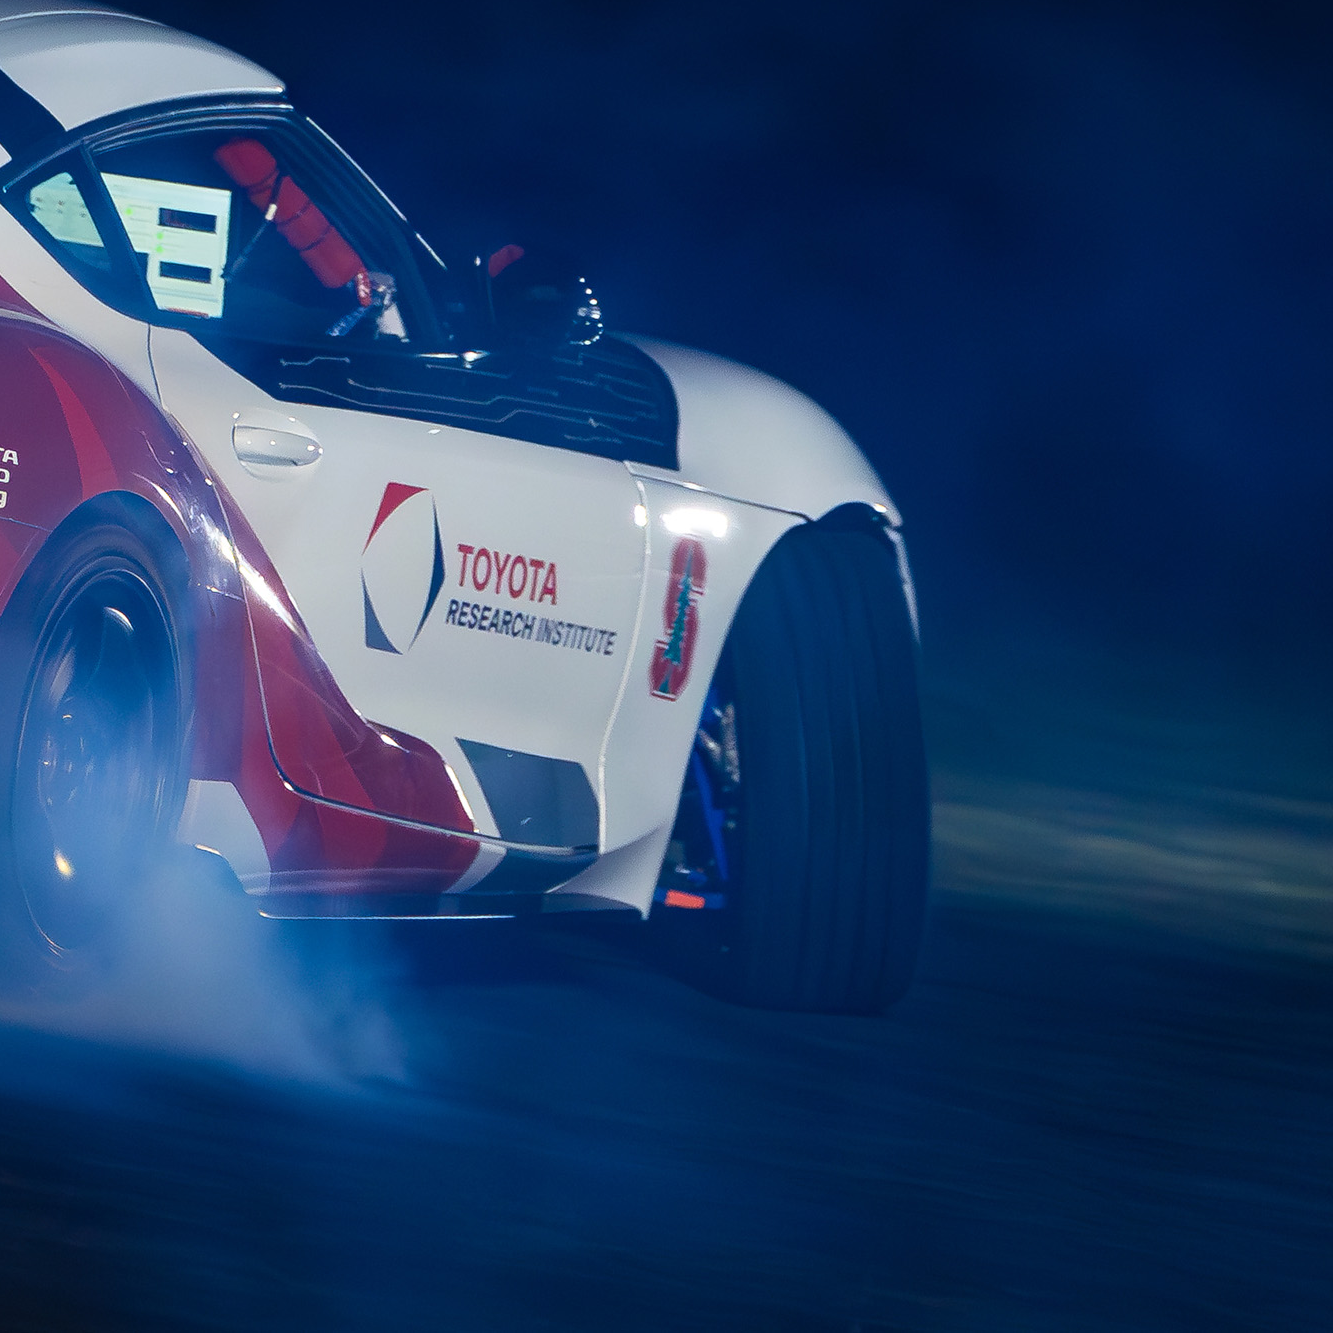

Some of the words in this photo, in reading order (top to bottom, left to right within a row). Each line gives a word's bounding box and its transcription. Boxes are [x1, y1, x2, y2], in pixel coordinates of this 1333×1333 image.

[457, 544, 558, 606] TOYOTA
[445, 599, 535, 640] RESEARCH
[535, 617, 618, 657] INSTITUTE
